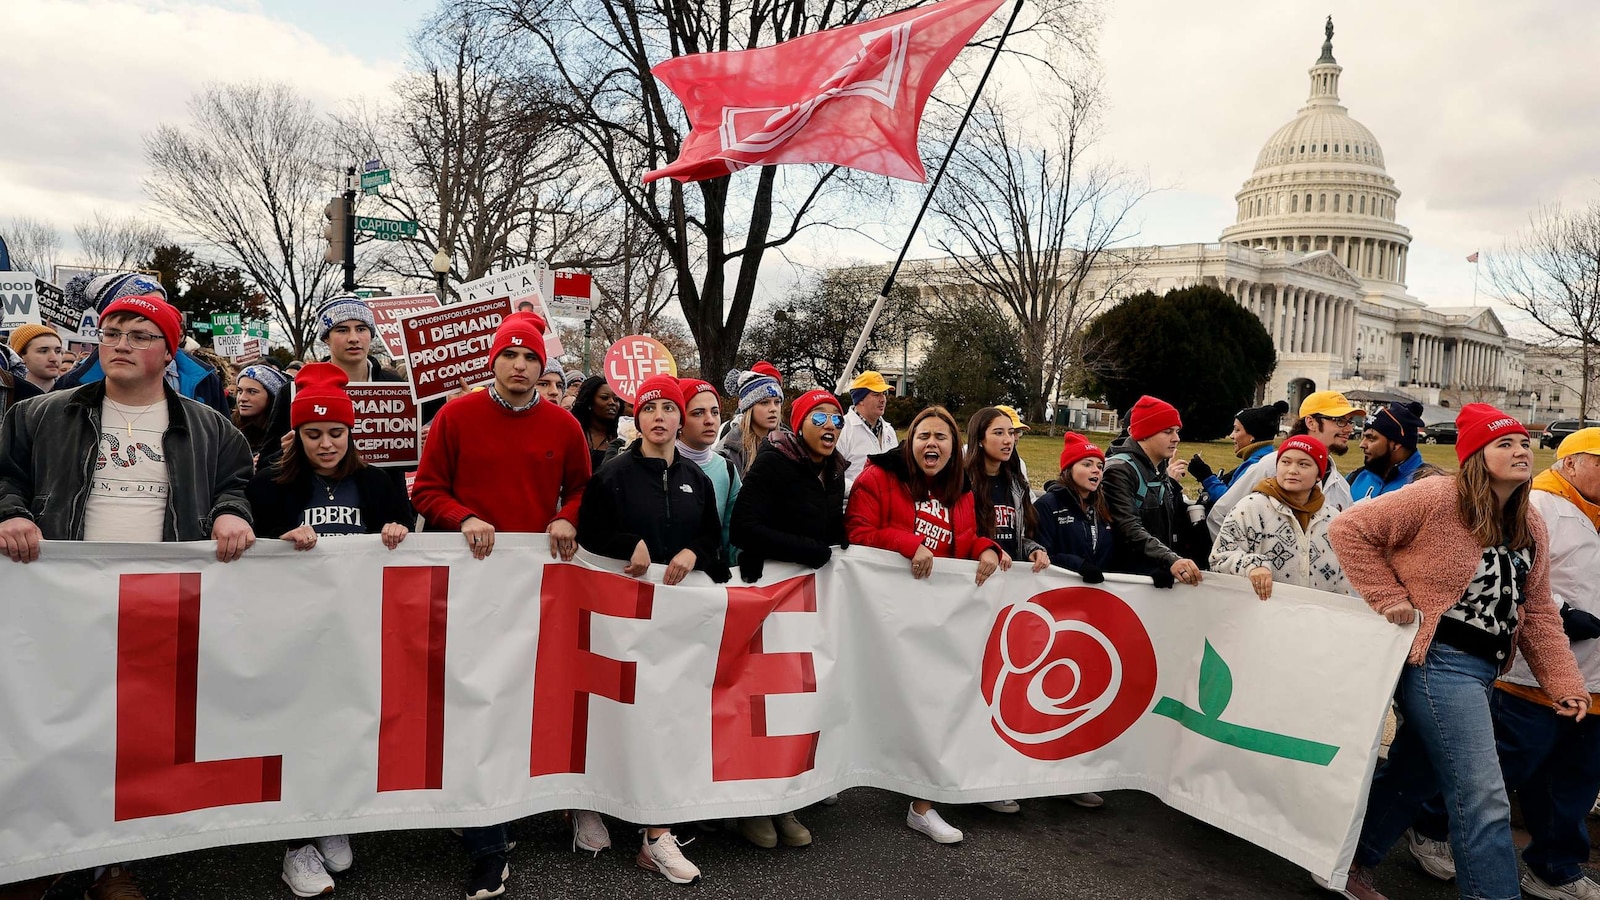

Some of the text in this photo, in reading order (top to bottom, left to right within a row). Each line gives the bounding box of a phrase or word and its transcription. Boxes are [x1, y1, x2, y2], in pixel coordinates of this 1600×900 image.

[360, 218, 405, 233] CAPITOL
[463, 285, 478, 293] SAVE
[479, 280, 495, 288] MORE
[496, 274, 517, 284] BABIES
[512, 287, 535, 297] VE.ORG
[43, 289, 60, 301] AM
[38, 295, 82, 320] OST-ROE
[418, 301, 506, 326] STUDENTSFORLIFEACTION.ORG
[214, 315, 240, 325] LOVE LIFE
[419, 313, 503, 345] I DEMAND
[218, 337, 241, 345] CHOOSE
[225, 346, 237, 355] LIFE
[409, 333, 497, 368] PROTECTI
[621, 341, 655, 360] LET
[419, 355, 490, 385] AT CONCEP
[610, 360, 671, 380] LIFE
[352, 400, 405, 414] MAND
[351, 418, 417, 433] ECTION
[353, 437, 414, 451] CEPTION
[303, 506, 361, 526] IBERT
[925, 537, 938, 550] 971
[114, 563, 821, 822] LIFE
